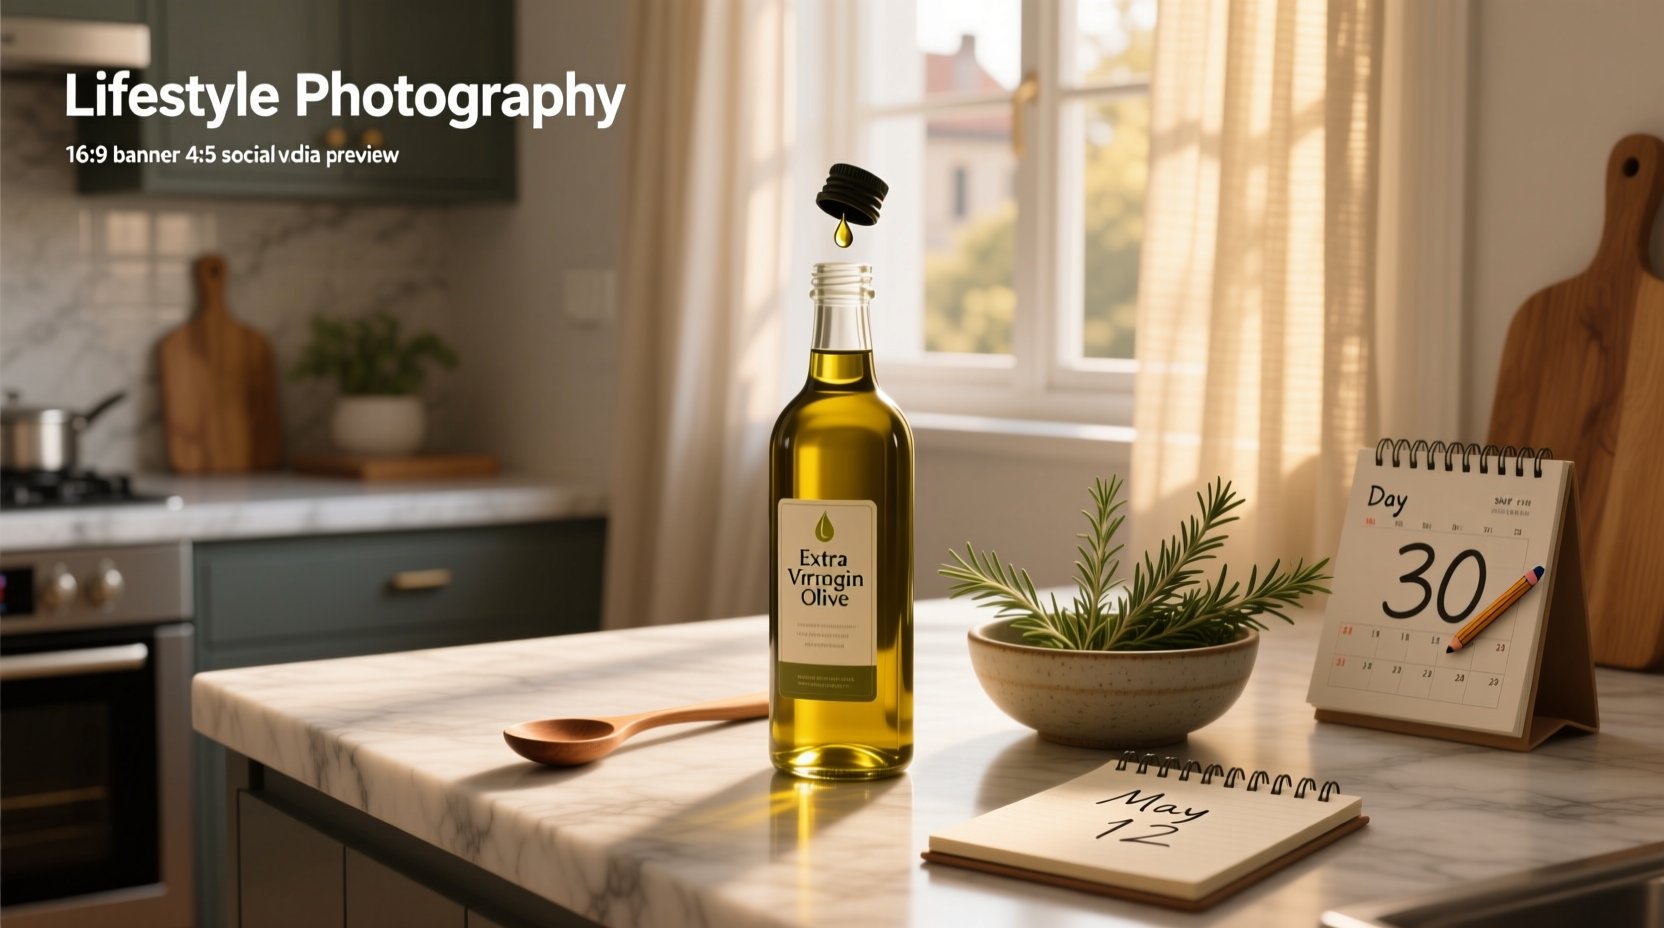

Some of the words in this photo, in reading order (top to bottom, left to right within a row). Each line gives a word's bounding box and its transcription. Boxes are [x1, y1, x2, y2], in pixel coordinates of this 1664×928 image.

[1367, 484, 1408, 518] Day
[800, 548, 848, 568] Extra
[801, 588, 850, 607] Olive
[1382, 542, 1488, 625] 30
[1095, 789, 1210, 824] May
[1095, 818, 1179, 848] 12
